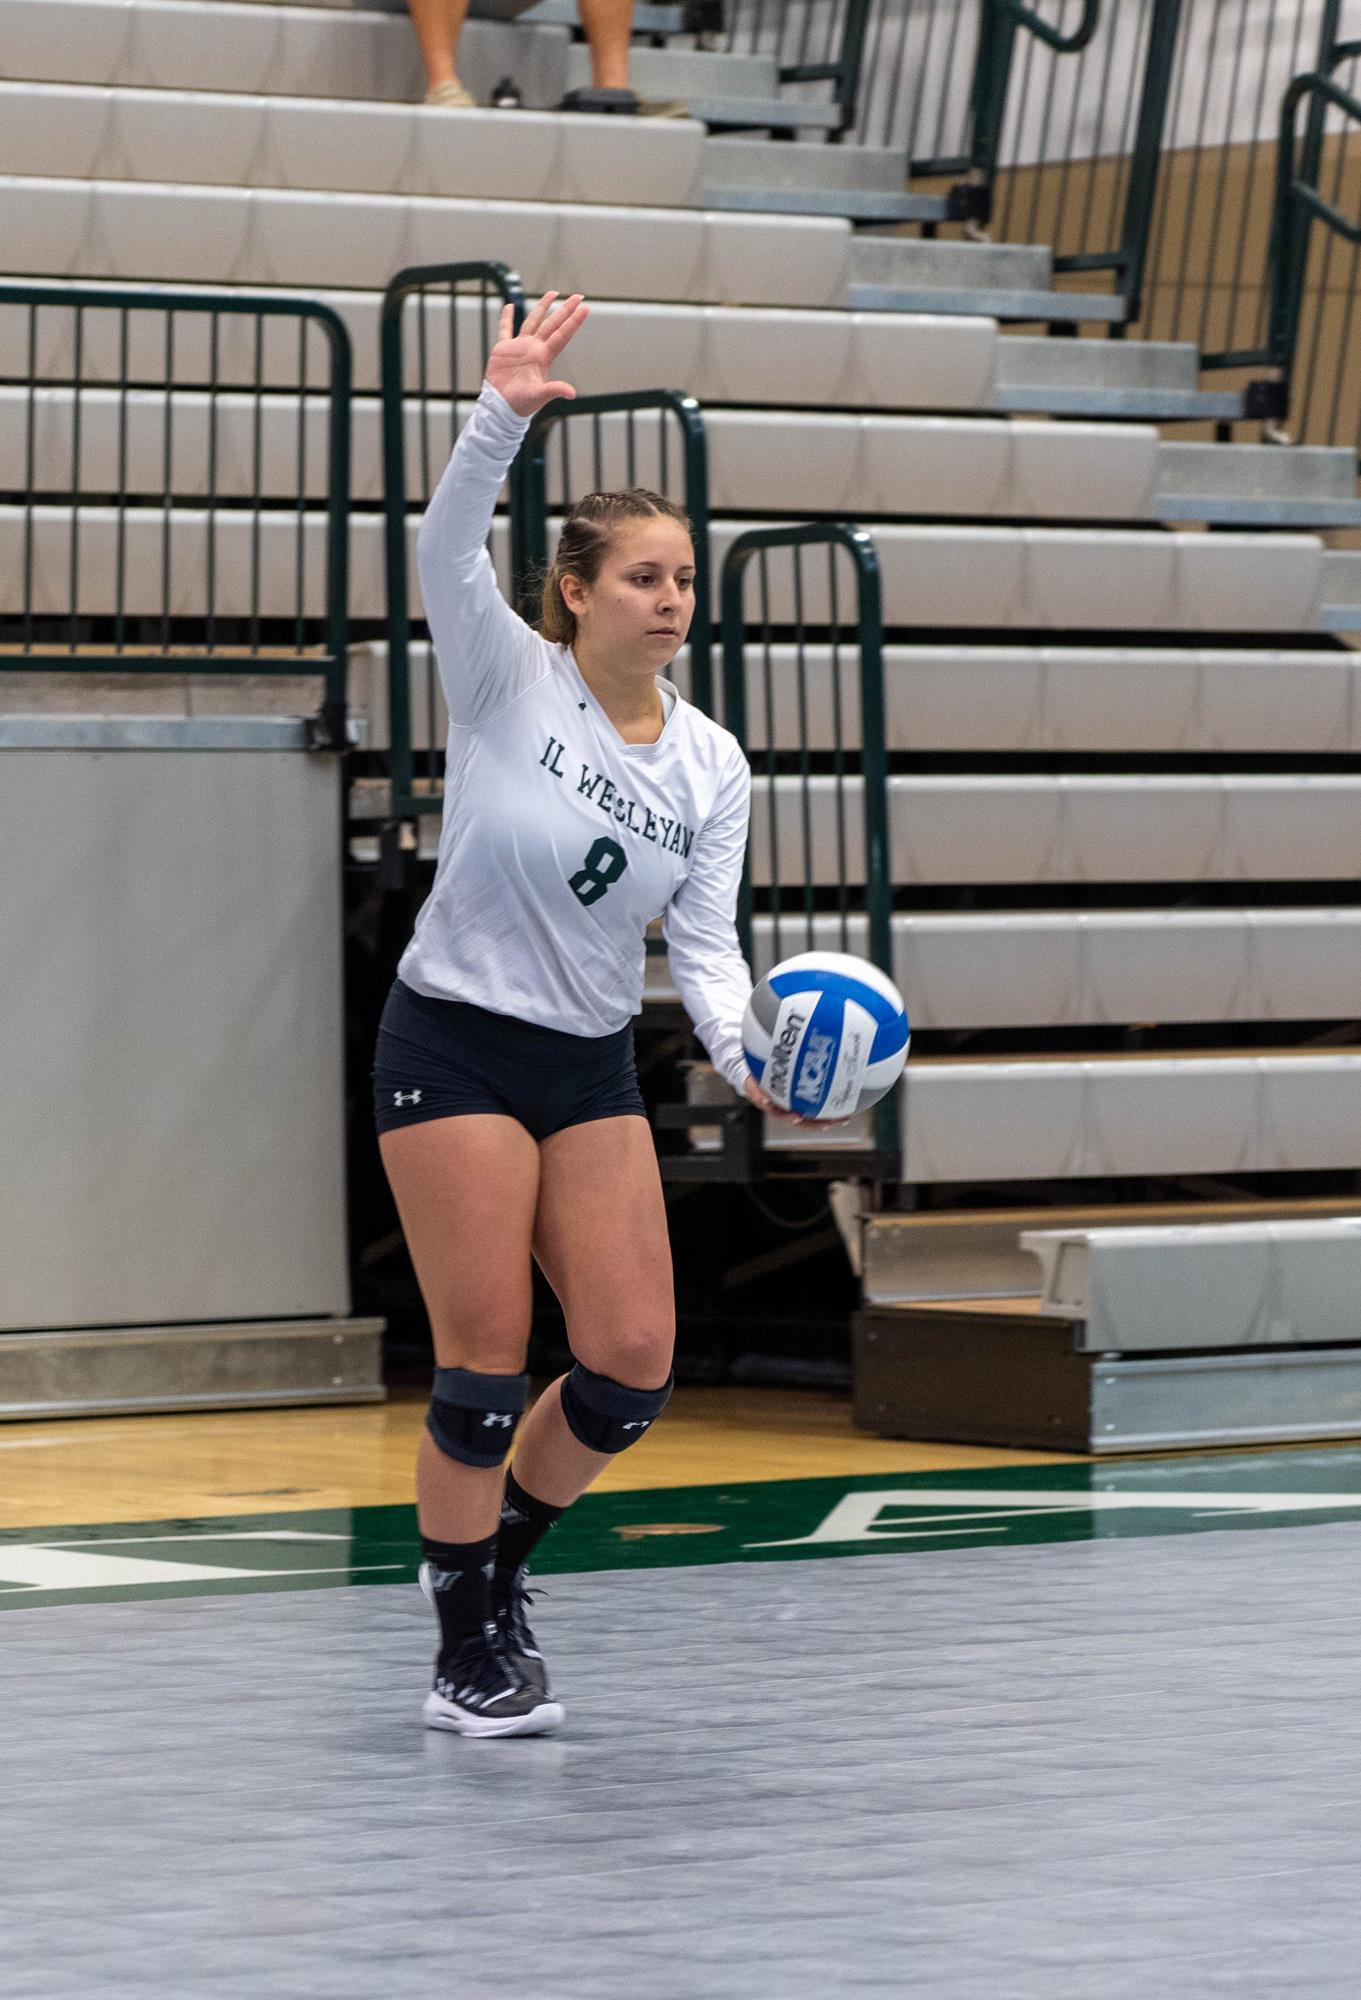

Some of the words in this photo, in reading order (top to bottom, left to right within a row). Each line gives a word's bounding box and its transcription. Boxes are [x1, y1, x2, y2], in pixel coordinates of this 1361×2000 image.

[539, 736, 565, 779] IL
[577, 763, 695, 859] WESLEYAN
[567, 835, 628, 907] 8
[769, 1012, 806, 1099] molten
